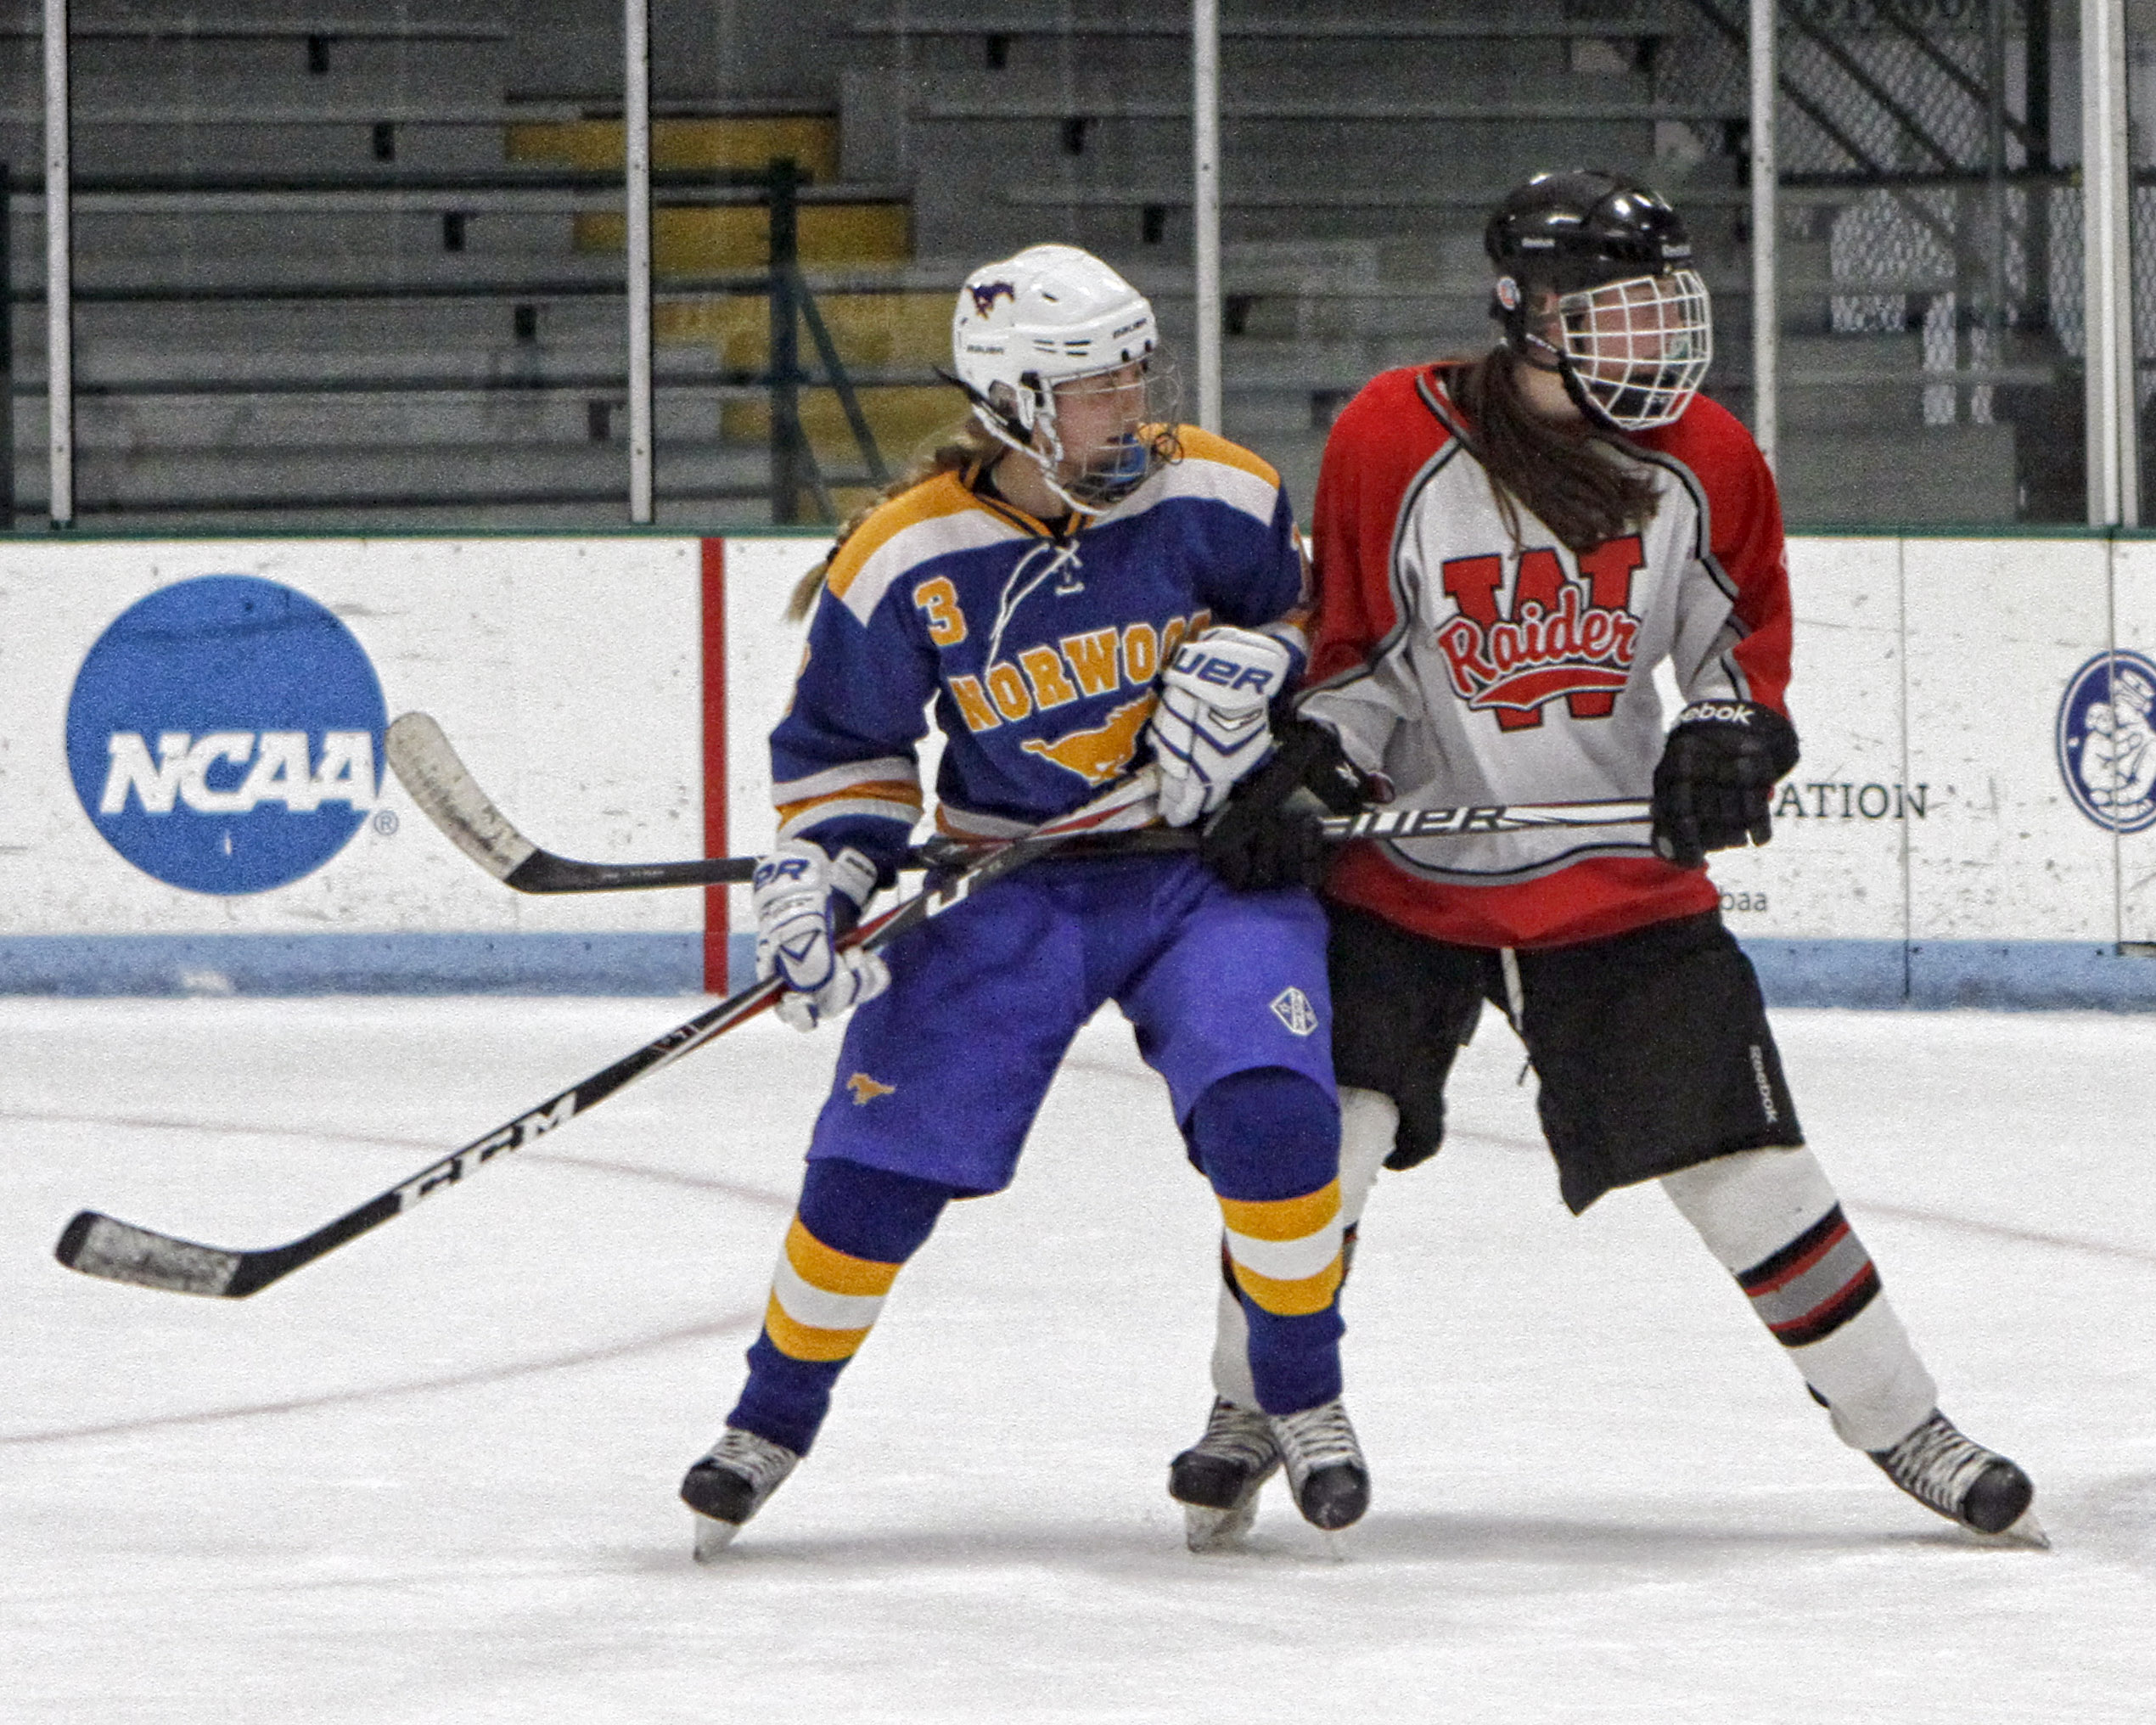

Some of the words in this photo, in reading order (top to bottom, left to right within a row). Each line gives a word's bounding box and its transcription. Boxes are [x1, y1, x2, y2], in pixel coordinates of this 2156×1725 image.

[912, 575, 969, 647] 3
[99, 731, 378, 813] NCAA
[1774, 782, 1929, 820] ATION
[397, 1090, 577, 1213] CCM
